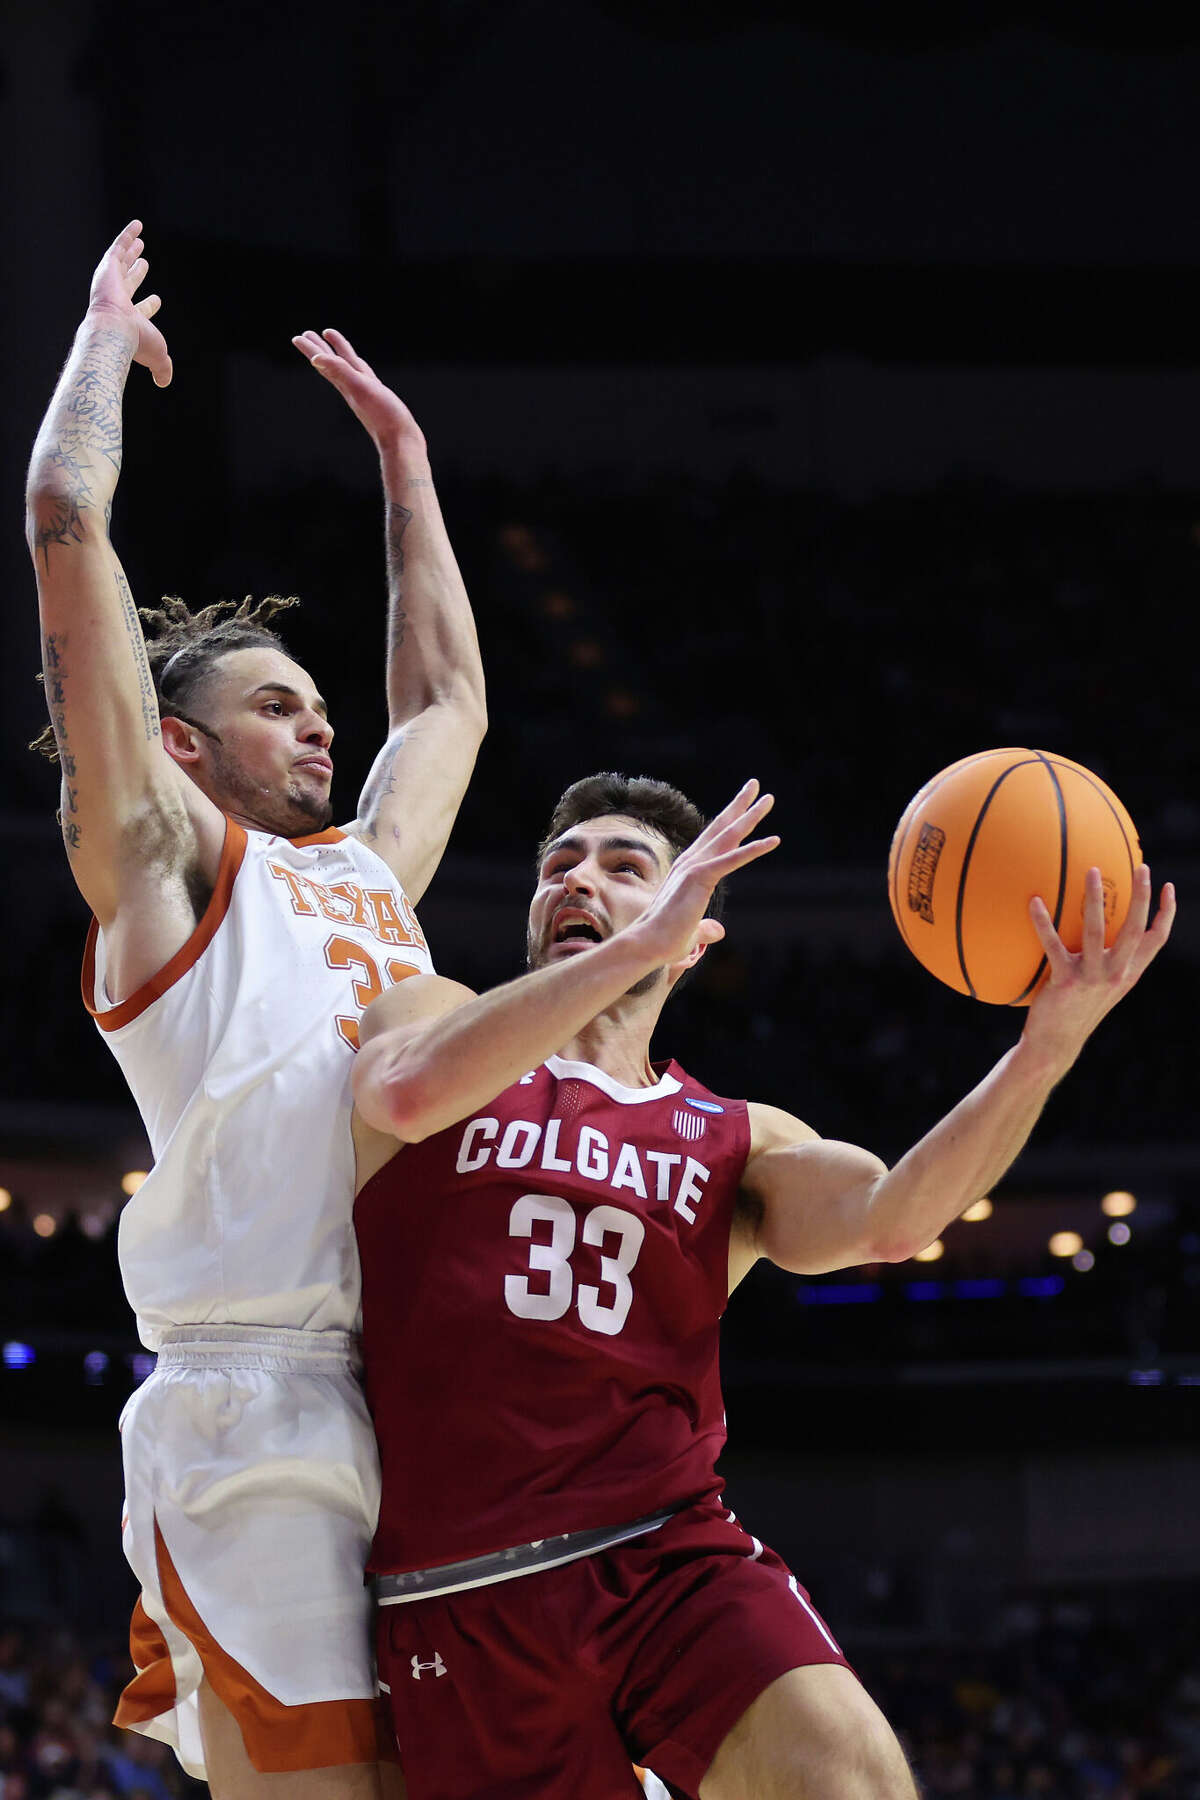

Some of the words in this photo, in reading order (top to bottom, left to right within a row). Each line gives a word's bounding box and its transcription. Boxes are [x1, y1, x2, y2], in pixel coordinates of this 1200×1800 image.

[323, 933, 422, 1054] 3
[455, 1117, 711, 1225] COLGATE
[504, 1194, 646, 1336] 33
